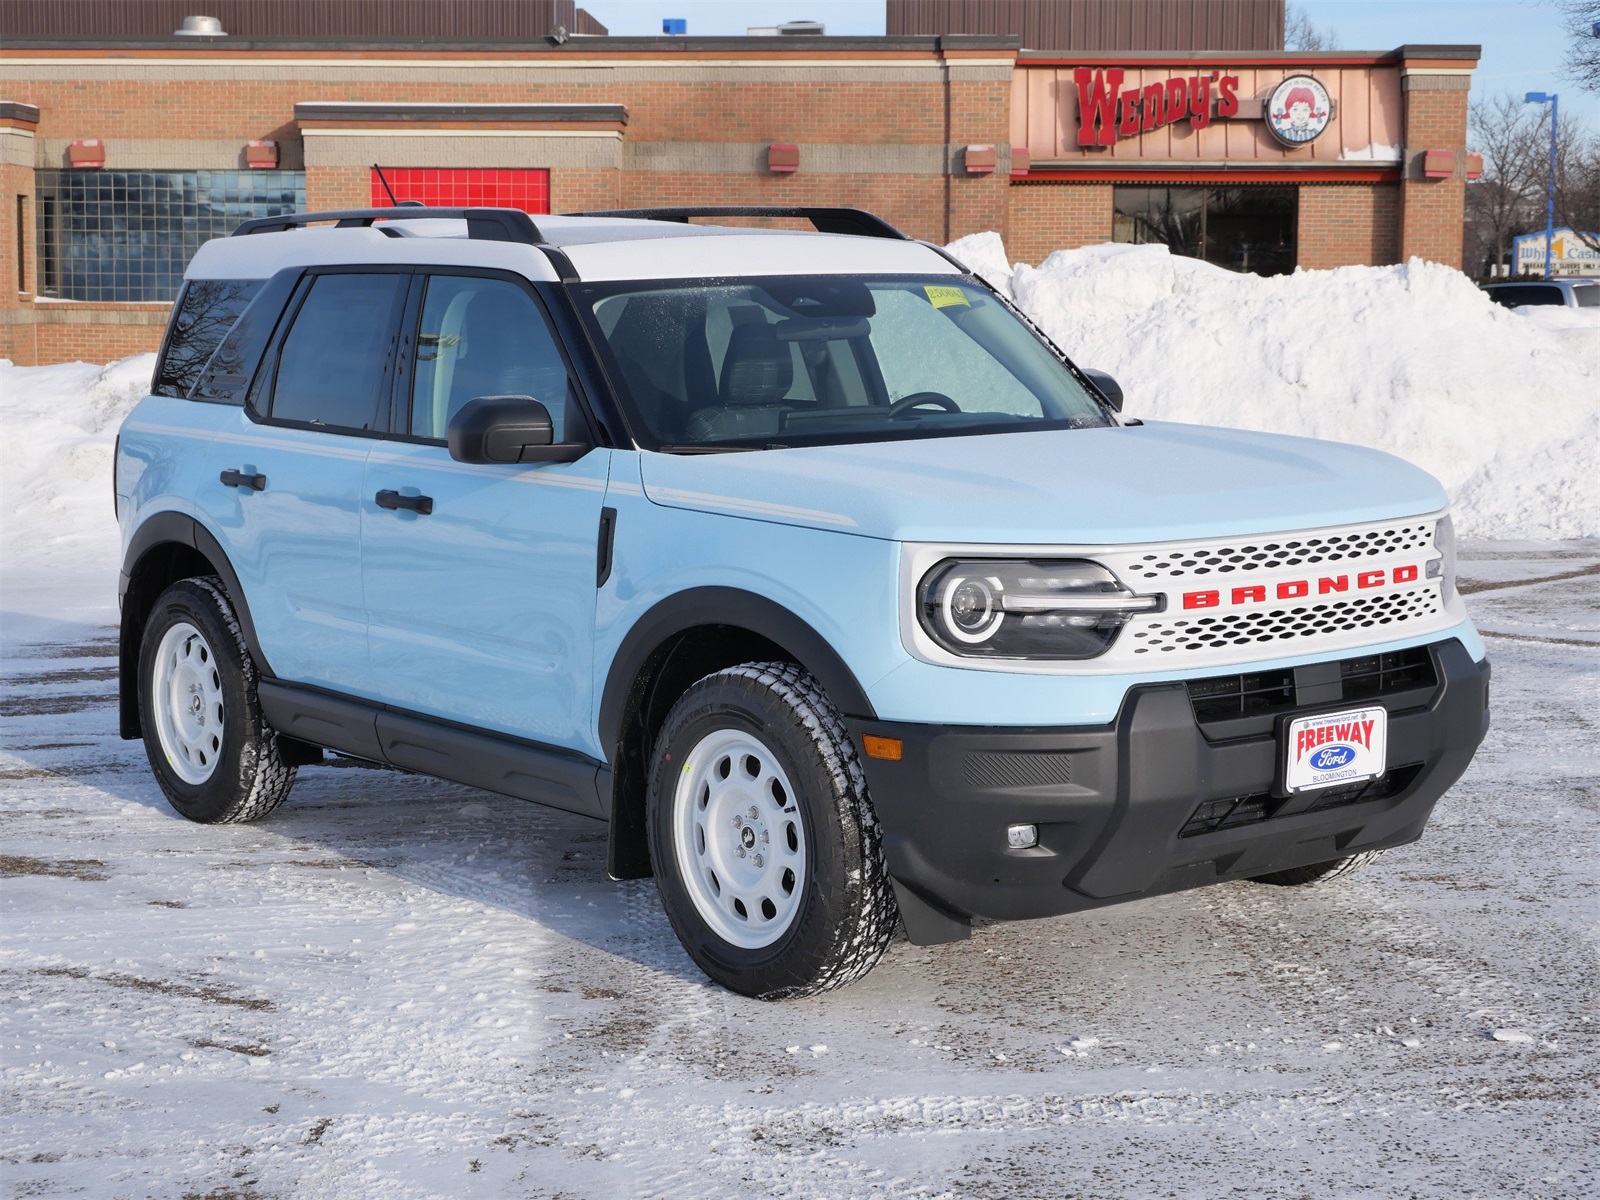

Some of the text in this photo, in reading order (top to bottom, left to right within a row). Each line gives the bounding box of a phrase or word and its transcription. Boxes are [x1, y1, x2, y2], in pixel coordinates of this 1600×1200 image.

[1073, 67, 1239, 146] Wendy's
[1520, 247, 1558, 260] Whie
[1183, 564, 1418, 610] BRONCO
[1297, 719, 1375, 766] FREEWAY
[1318, 748, 1348, 767] Ford
[1312, 769, 1357, 783] BLOOMINGTON
